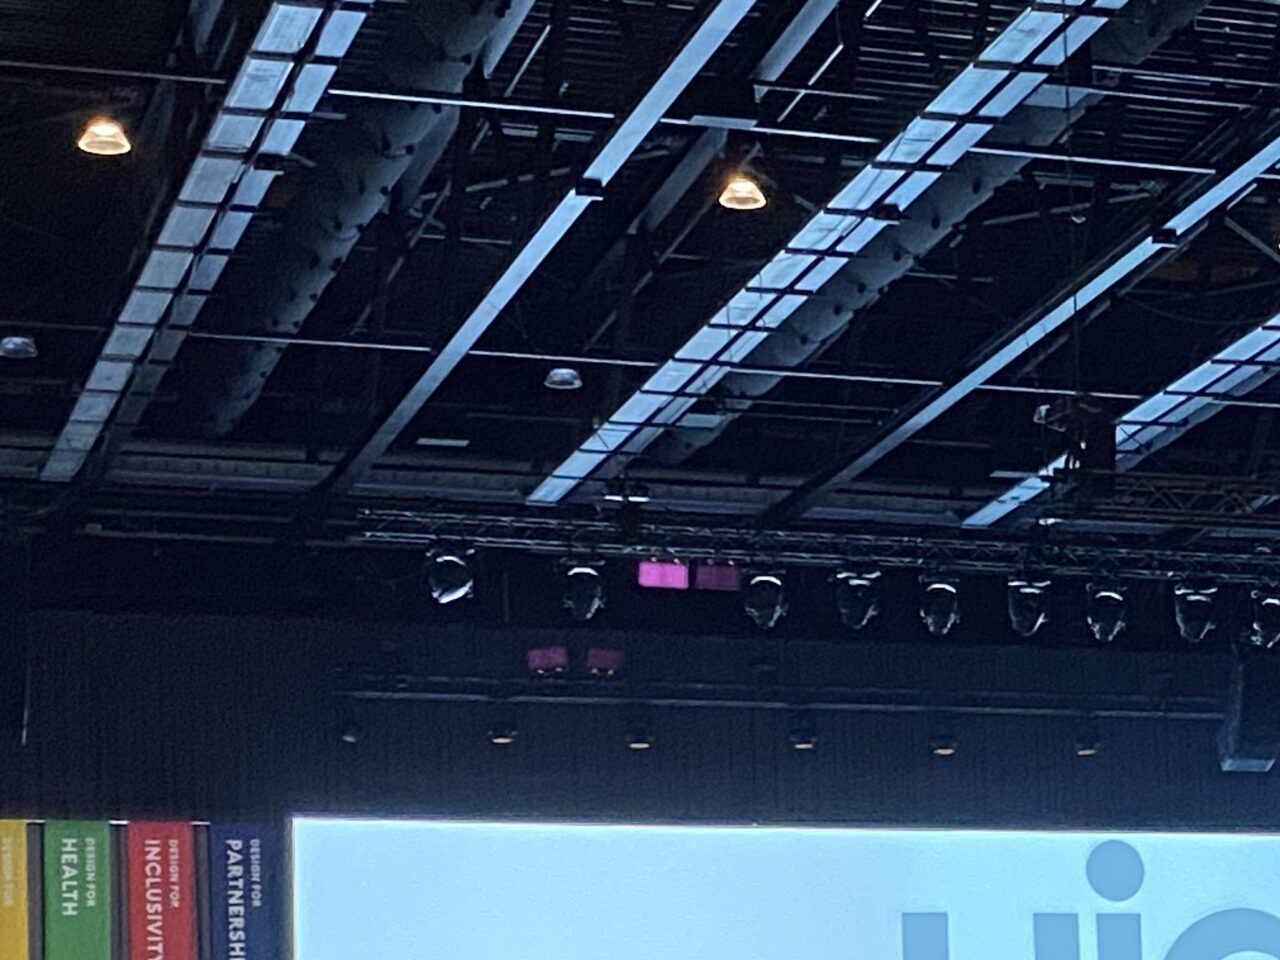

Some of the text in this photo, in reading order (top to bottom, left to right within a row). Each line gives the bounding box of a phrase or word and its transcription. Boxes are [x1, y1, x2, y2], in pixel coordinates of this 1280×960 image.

[61, 838, 79, 916] HEALTH
[85, 838, 97, 907] DESIGN FOR
[168, 839, 180, 908] DESIGN FOR
[250, 839, 262, 907] DESIGN FOR
